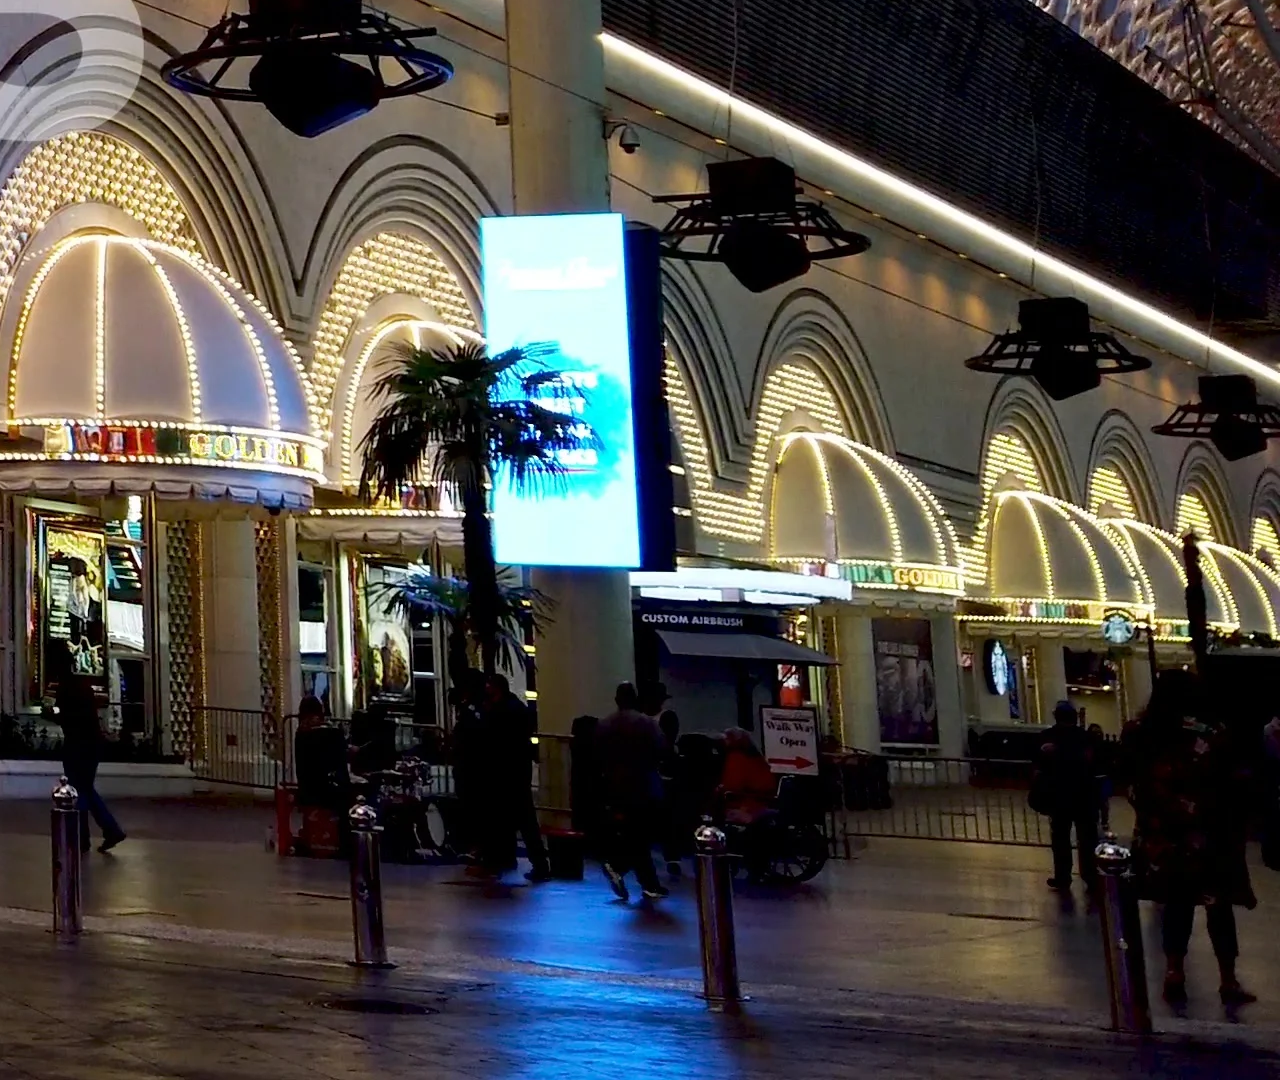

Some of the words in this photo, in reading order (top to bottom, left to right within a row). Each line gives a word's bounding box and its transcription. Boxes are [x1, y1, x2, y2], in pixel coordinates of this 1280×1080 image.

[189, 433, 299, 467] GOLDEN
[641, 613, 689, 625] CUSTOM
[691, 616, 744, 627] AIRBRUSH
[765, 720, 791, 731] Walk
[779, 736, 807, 749] Open
